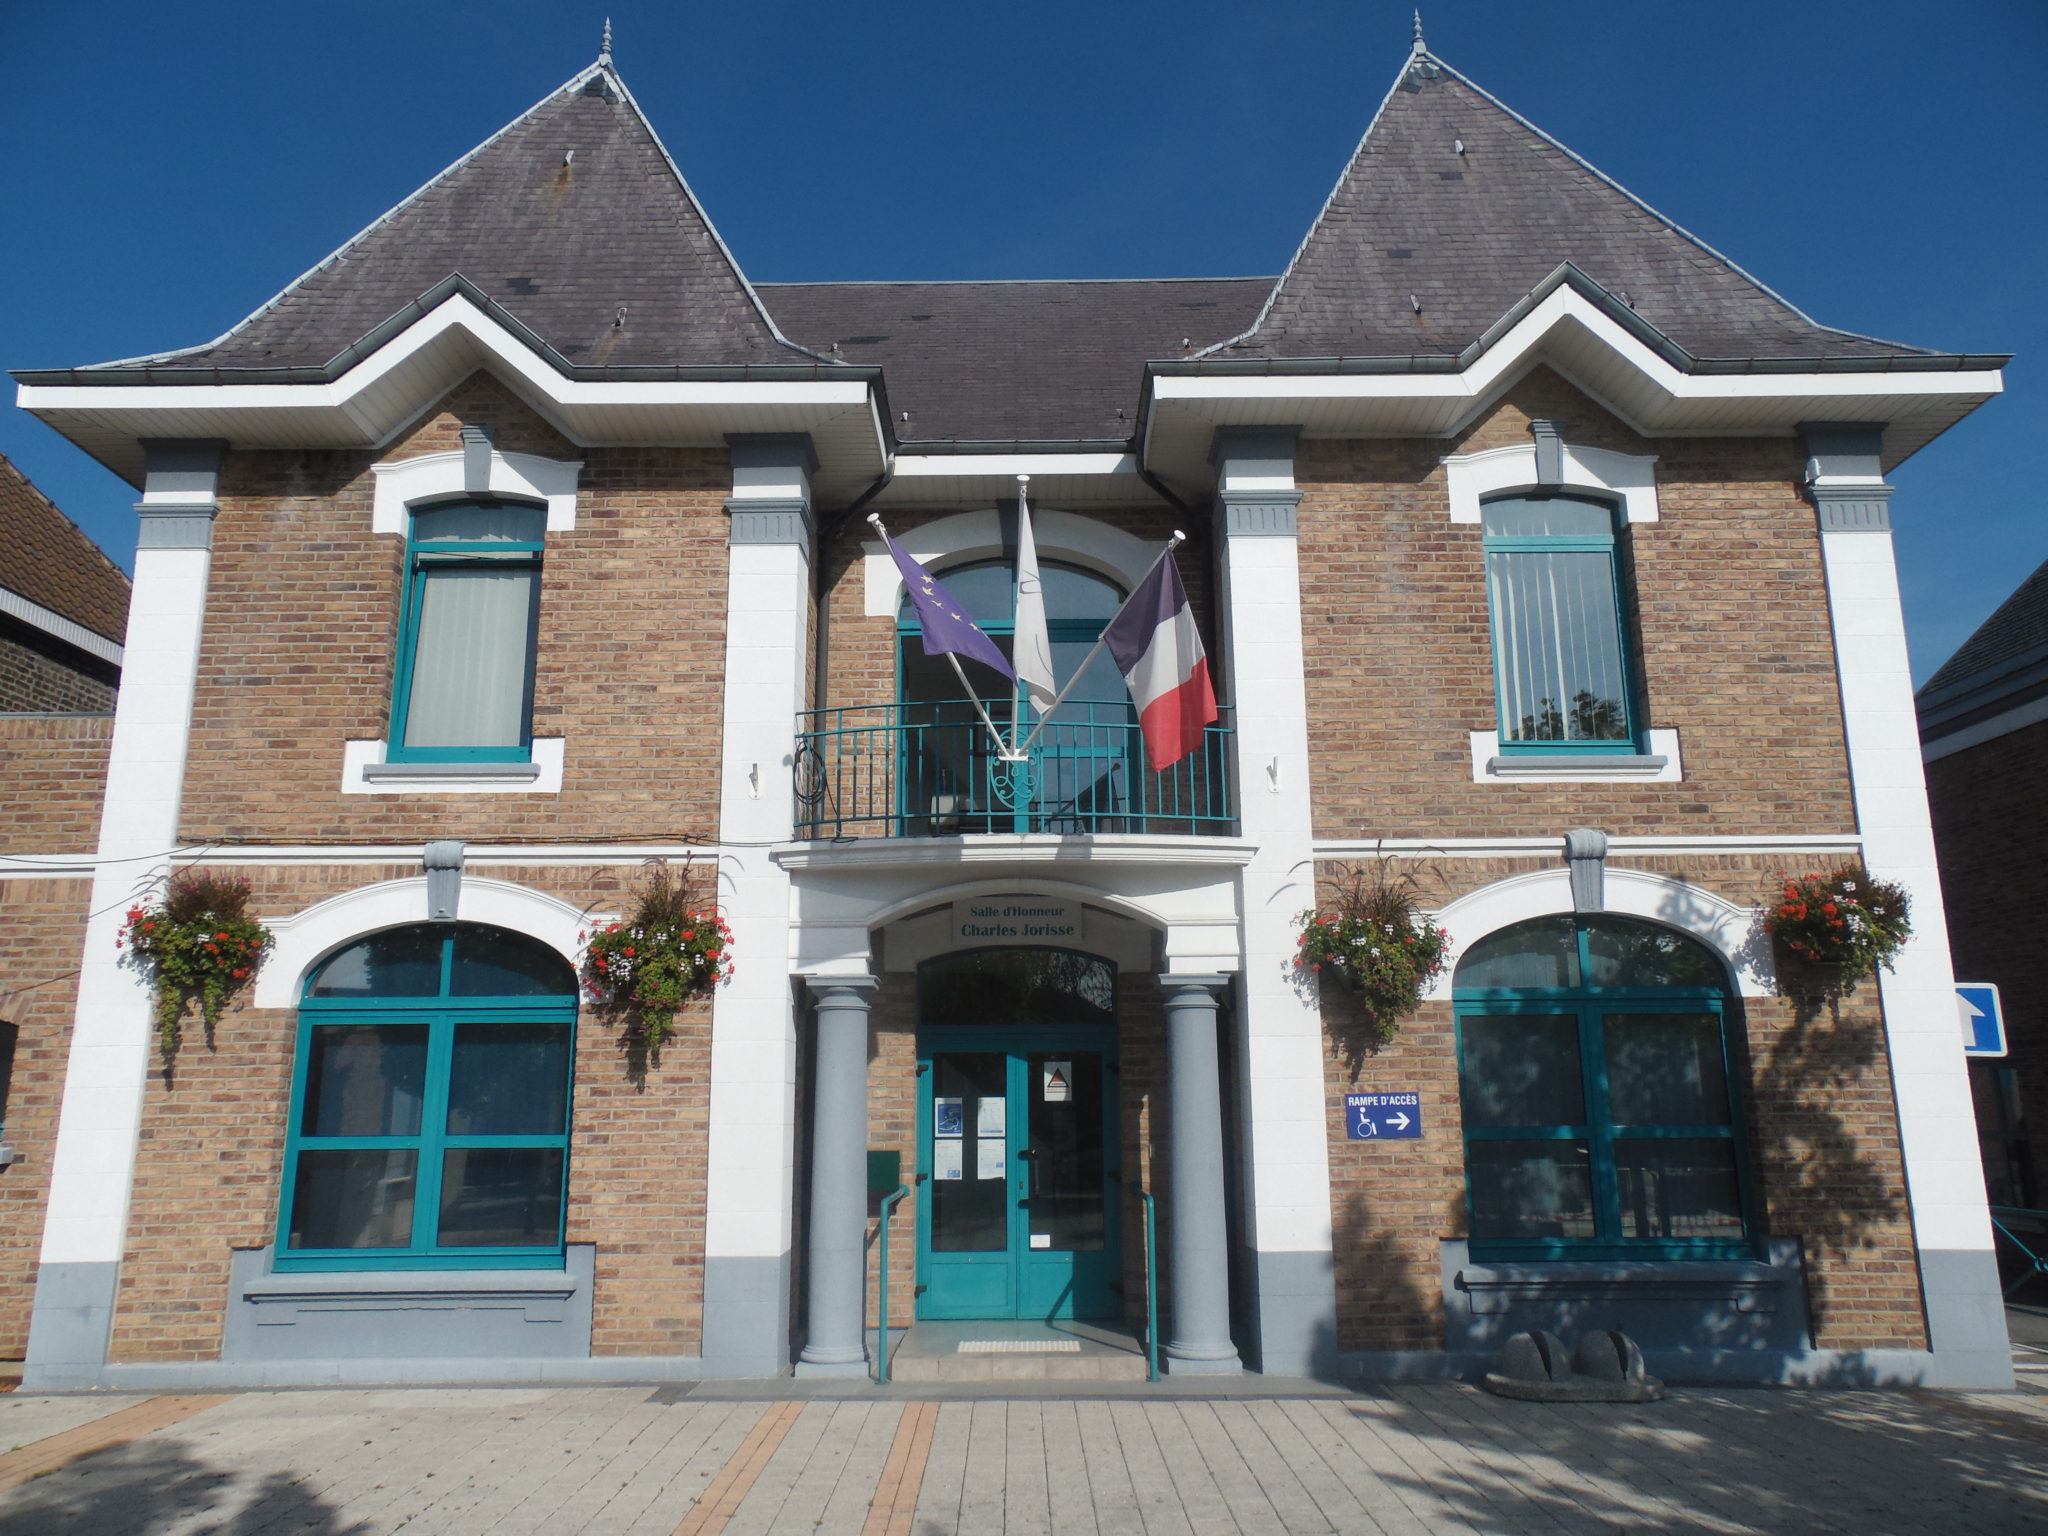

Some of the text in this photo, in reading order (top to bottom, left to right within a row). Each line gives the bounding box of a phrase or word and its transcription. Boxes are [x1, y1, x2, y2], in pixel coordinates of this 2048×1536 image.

[970, 906, 1064, 917] Salle d'Honneur
[961, 924, 1074, 937] Charles Jorisse
[1348, 1094, 1417, 1106] RAMPE D'ACCÈS
